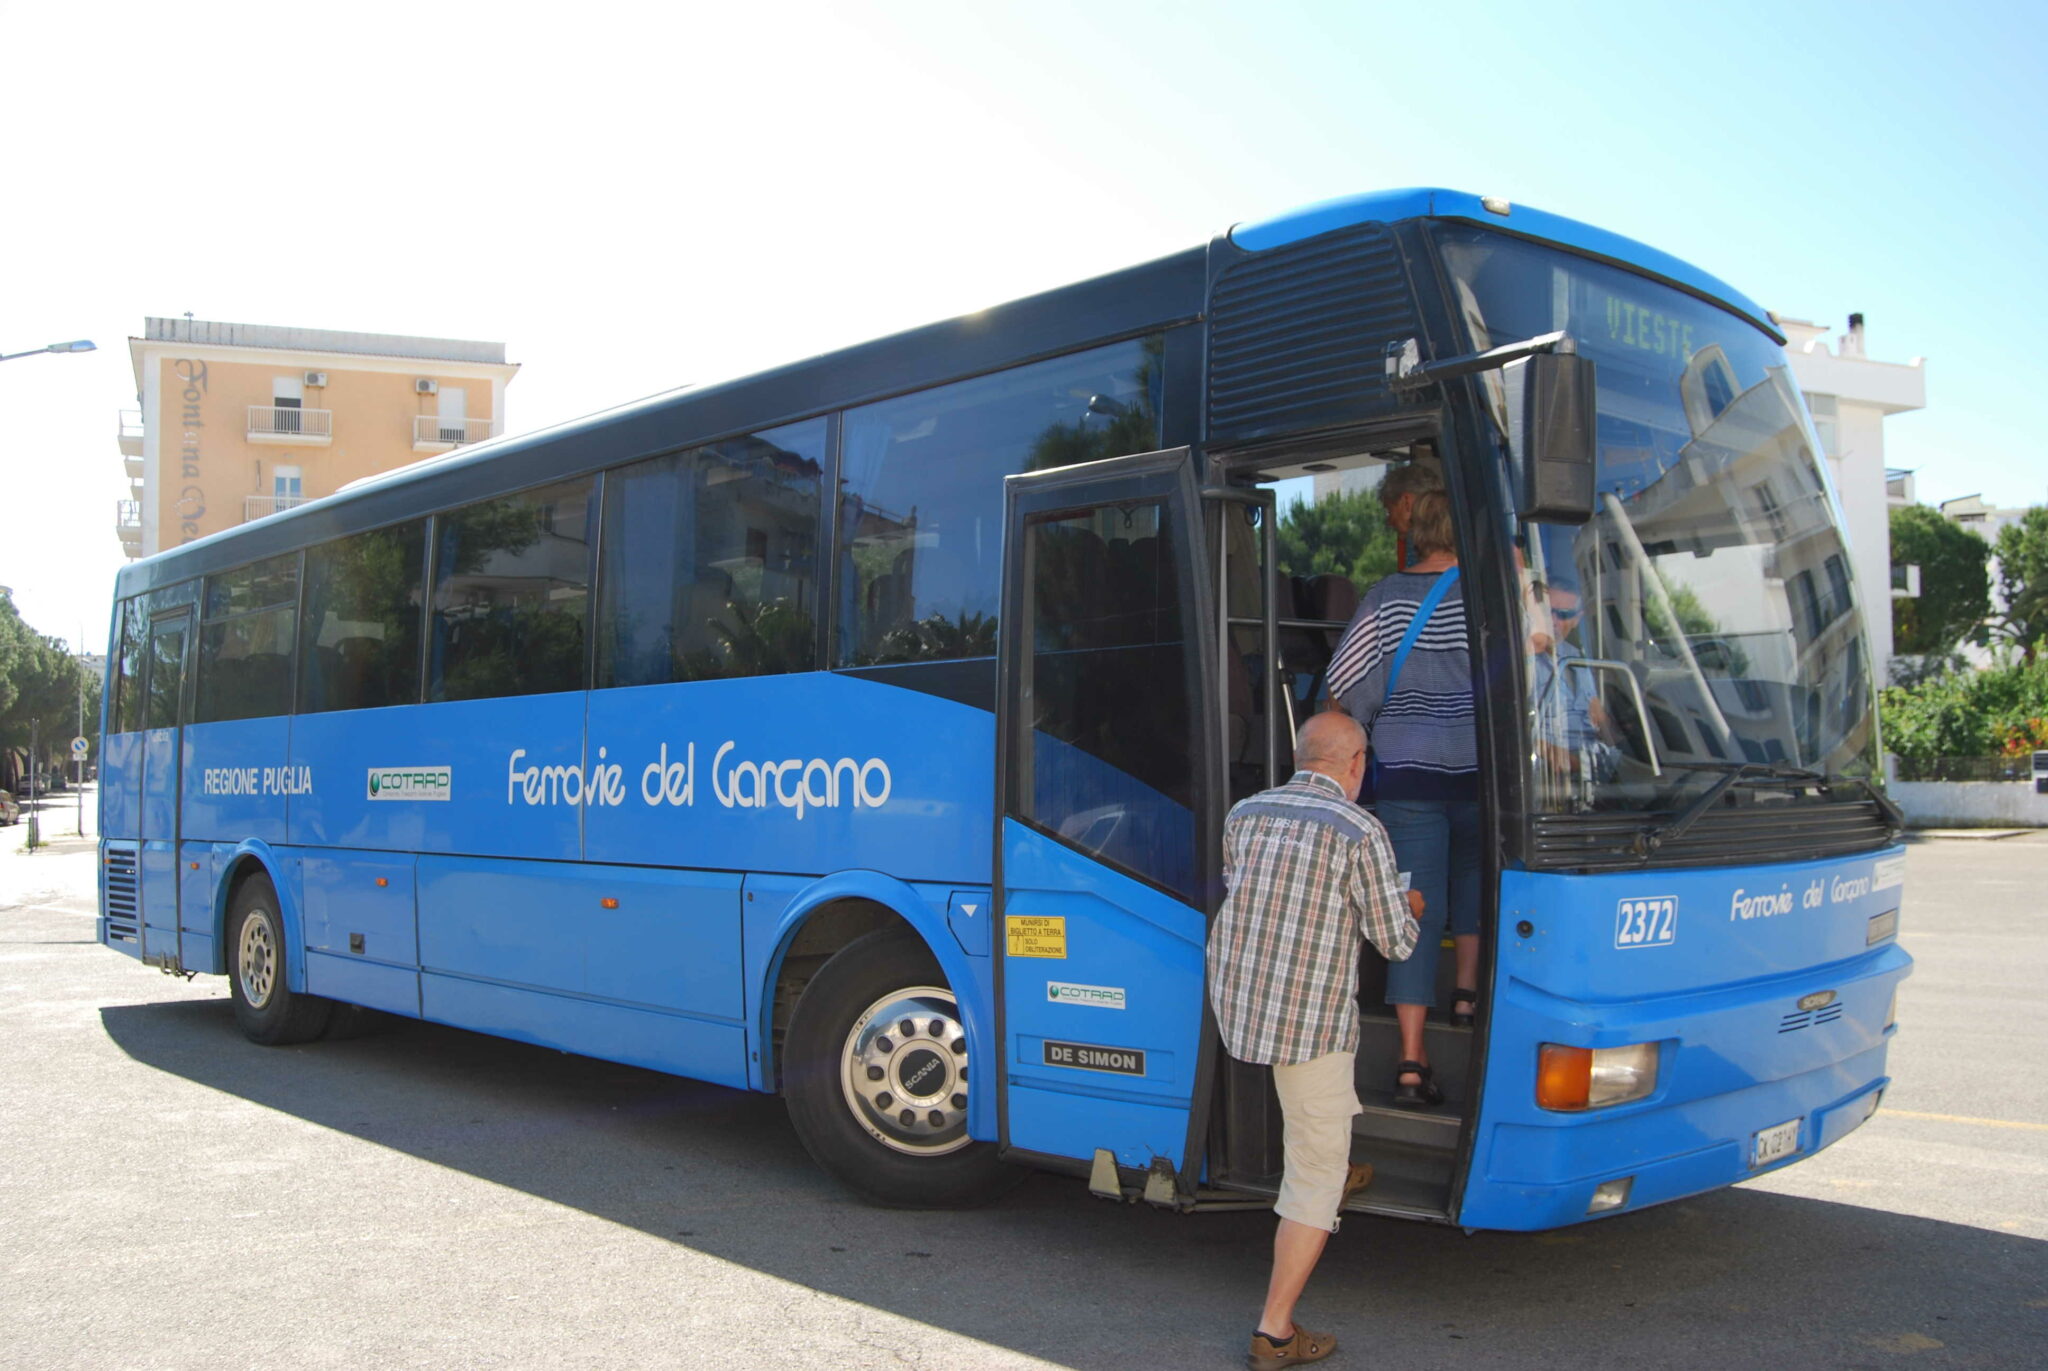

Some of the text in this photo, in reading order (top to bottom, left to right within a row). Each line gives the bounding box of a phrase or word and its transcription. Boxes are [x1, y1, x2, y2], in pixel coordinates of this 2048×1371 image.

[1606, 296, 1694, 367] VIESTE
[204, 766, 313, 795] REGIONE PUGLIA
[381, 772, 449, 790] COTRAP
[508, 740, 892, 820] Ferrovie del Gargano
[1730, 883, 1793, 921] Ferrovie
[1803, 878, 1825, 909] del
[1010, 927, 1037, 936] BIGLIETTO
[1043, 928, 1061, 936] TERRA
[1618, 900, 1674, 944] 2372
[1060, 986, 1124, 1001] COTRAP
[1051, 1047, 1136, 1070] DE SIMON
[904, 1058, 941, 1090] SCANIA
